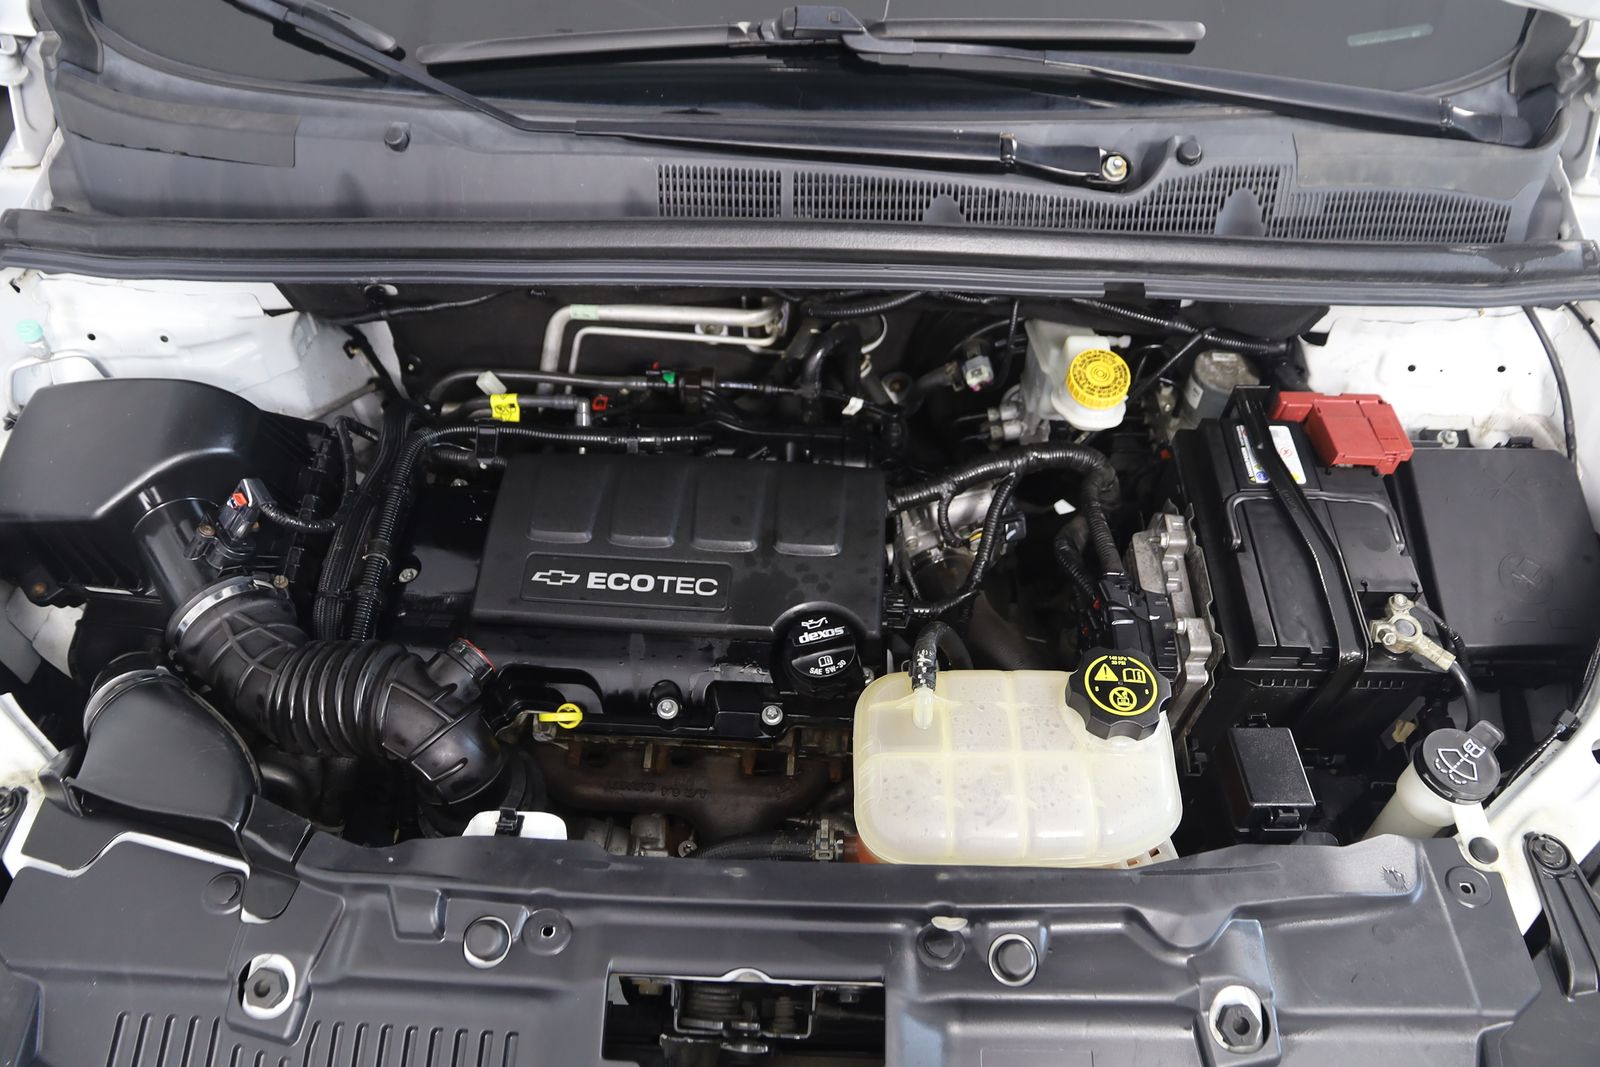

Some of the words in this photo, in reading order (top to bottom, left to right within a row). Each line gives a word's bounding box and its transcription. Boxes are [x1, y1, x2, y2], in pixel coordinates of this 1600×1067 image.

[586, 571, 719, 597] ECOTEC
[798, 627, 844, 644] dexos
[809, 667, 823, 675] SAE
[825, 659, 847, 674] 5W-30
